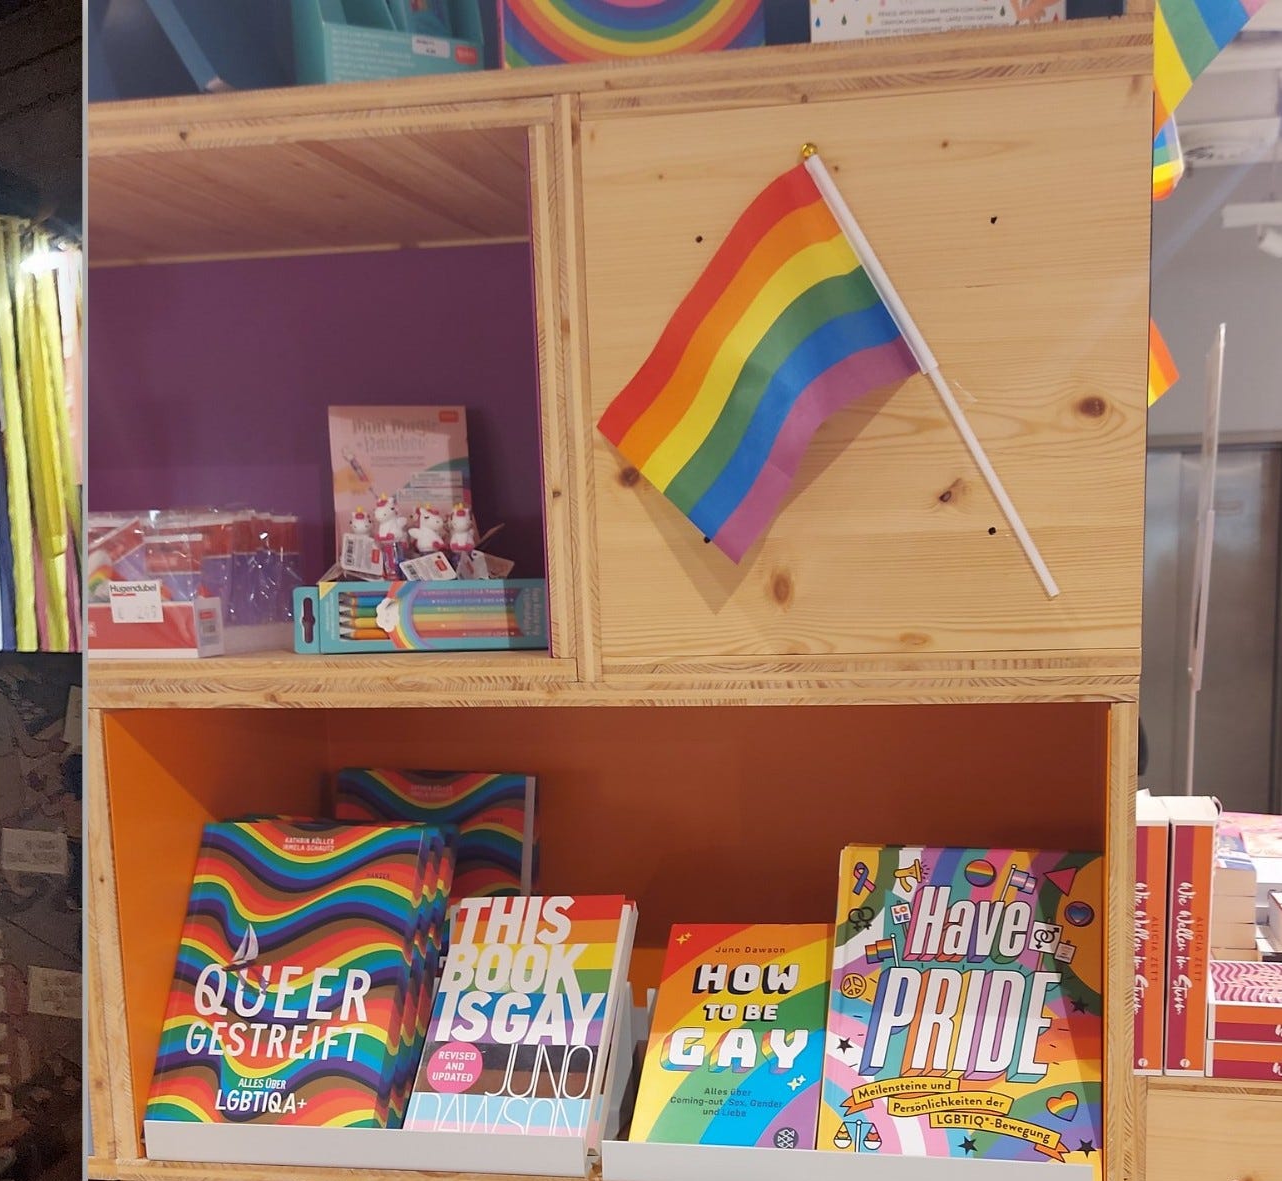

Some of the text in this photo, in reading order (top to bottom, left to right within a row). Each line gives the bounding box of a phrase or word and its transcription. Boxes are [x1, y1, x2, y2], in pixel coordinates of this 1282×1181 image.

[110, 583, 157, 592] Hugendubel
[283, 843, 335, 852] IRMELA SCHAUTZ
[285, 836, 335, 845] KATHRIN KÖLLER
[459, 896, 576, 944] THIS
[905, 886, 1031, 961] Have
[1172, 881, 1196, 1015] Wie Wellen im Sturm
[1194, 917, 1205, 982] ALICIA ZETT
[440, 943, 588, 993] BOOK
[693, 963, 800, 994] HOW
[1150, 957, 1158, 981] ZETT
[194, 964, 372, 1021] QUEER
[704, 1004, 779, 1021] TO BE
[862, 967, 1062, 1081] PRIDE
[185, 1021, 365, 1062] GESTREIFT
[661, 1027, 809, 1073] GAY
[438, 1051, 477, 1061] REVISED
[444, 1062, 465, 1071] AND
[432, 1072, 474, 1083] UPDATED
[485, 1043, 594, 1099] JUNO
[238, 1078, 287, 1090] ALLES ÜBER
[704, 1087, 752, 1097] Alles über
[858, 1080, 952, 1099] Meilensteine und
[215, 1089, 308, 1114] LGBTIQA+
[702, 1108, 747, 1117] und Liebe
[749, 1100, 783, 1108] Gender
[893, 1096, 1005, 1113] Persönlichkeiten der
[411, 1092, 586, 1136] DAWSON
